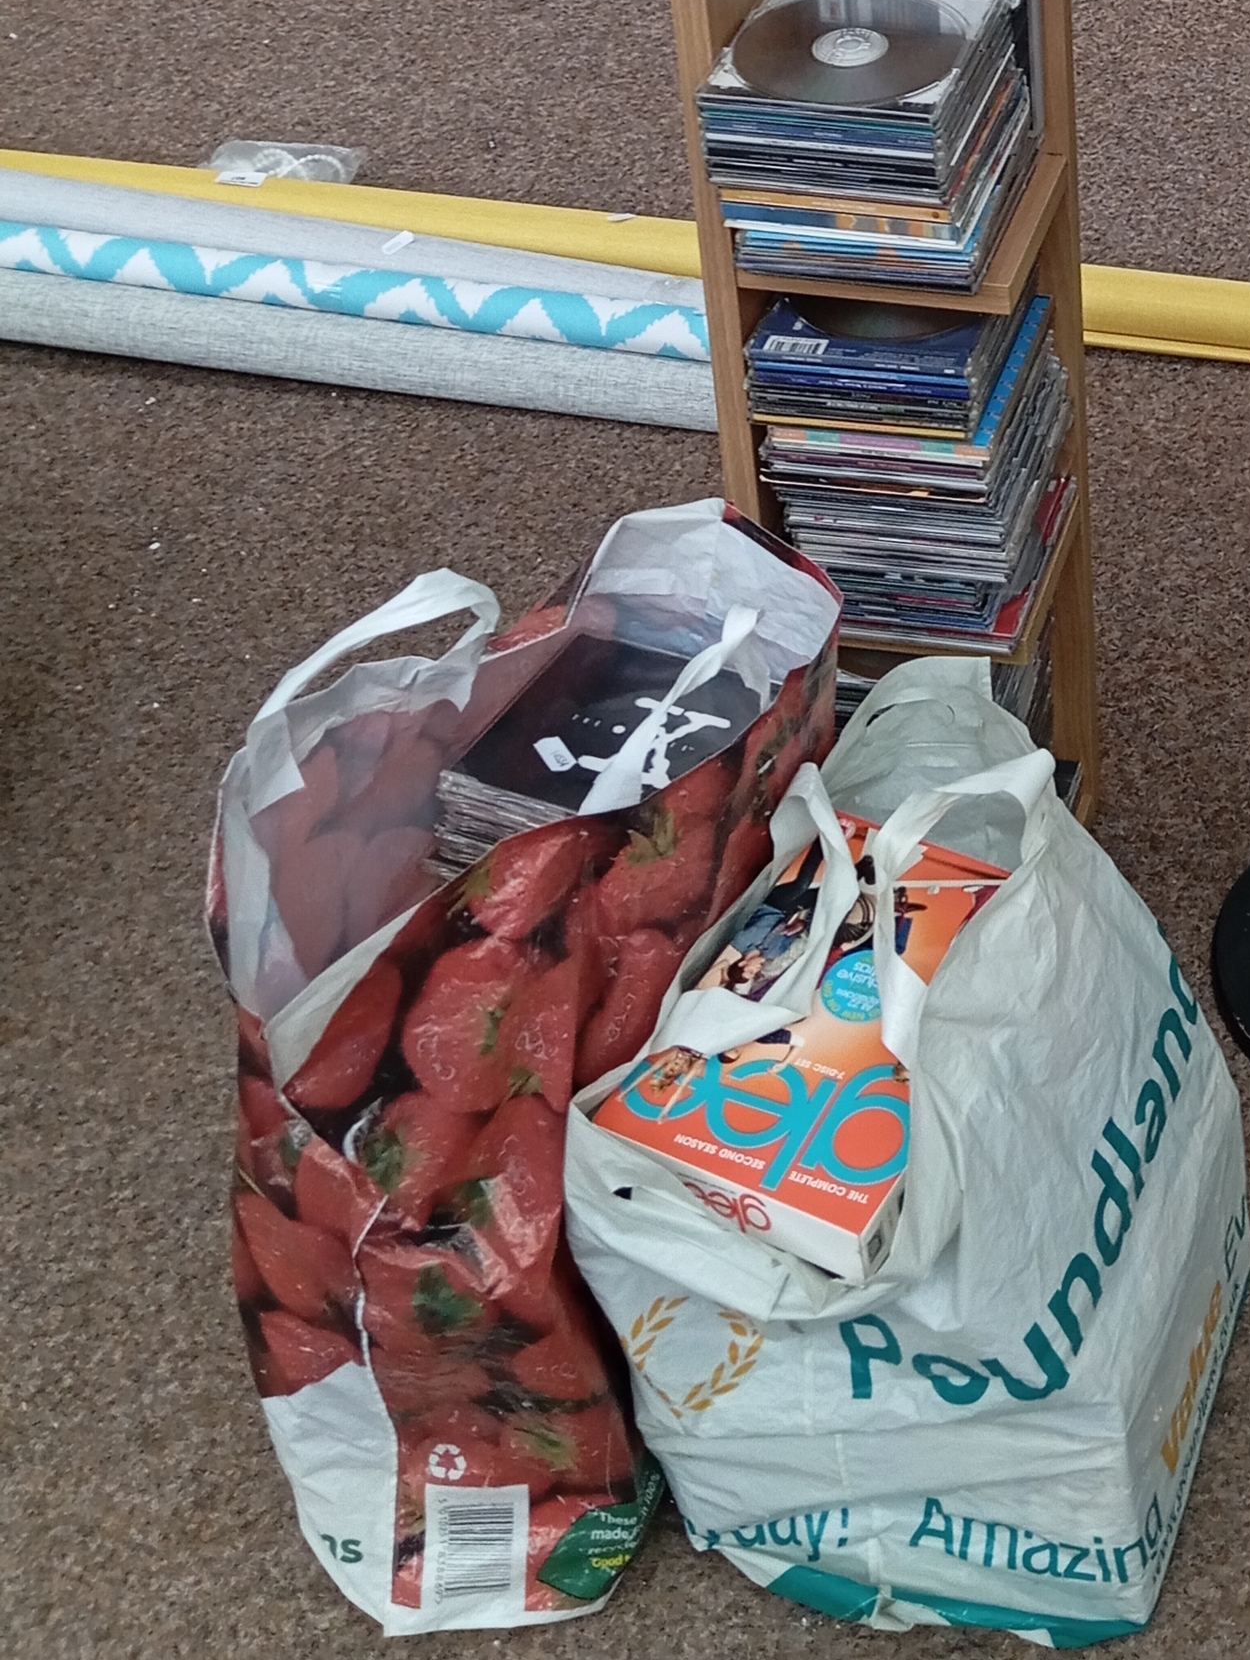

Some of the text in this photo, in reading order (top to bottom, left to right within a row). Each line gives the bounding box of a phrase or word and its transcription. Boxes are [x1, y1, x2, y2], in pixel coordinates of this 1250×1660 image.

[793, 1057, 846, 1080] 7-DISC SET
[673, 1133, 870, 1206] THE COMPLETE SECOND SEASON
[599, 1511, 638, 1527] These
[590, 1526, 629, 1541] made
[591, 1556, 624, 1569] Good
